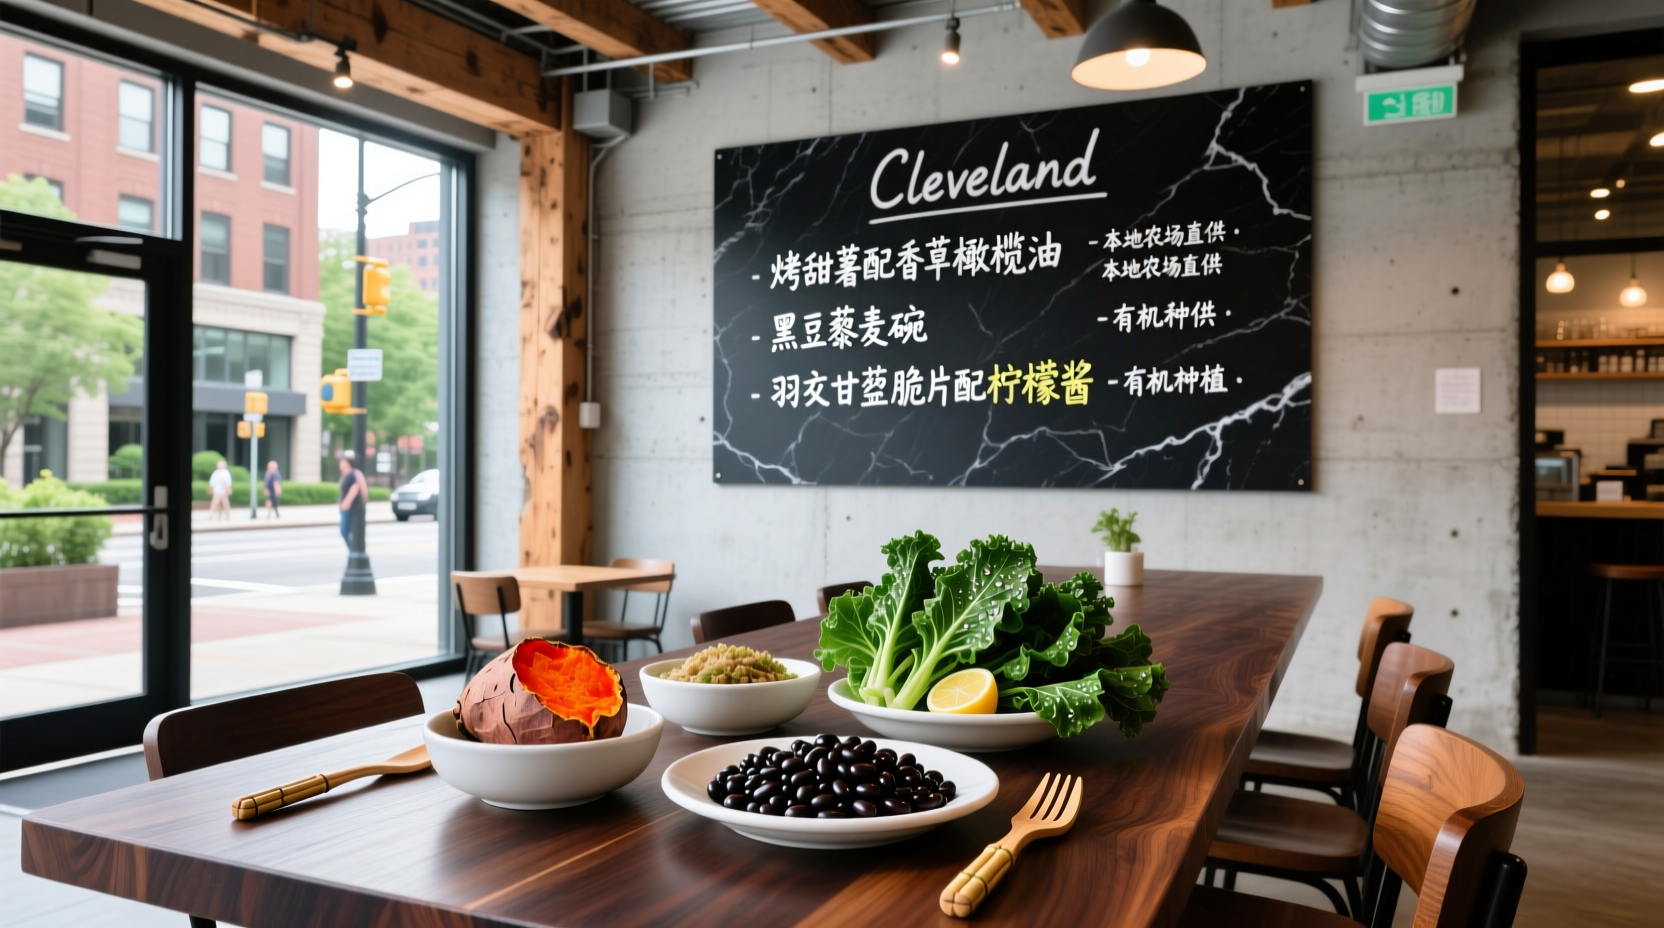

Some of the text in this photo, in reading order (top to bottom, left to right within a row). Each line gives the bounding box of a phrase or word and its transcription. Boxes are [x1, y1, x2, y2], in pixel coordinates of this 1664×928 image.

[870, 127, 1100, 209] Cleveland
[1101, 252, 1223, 282] 本地农场直供
[771, 304, 928, 352] 黑豆藜麦碗
